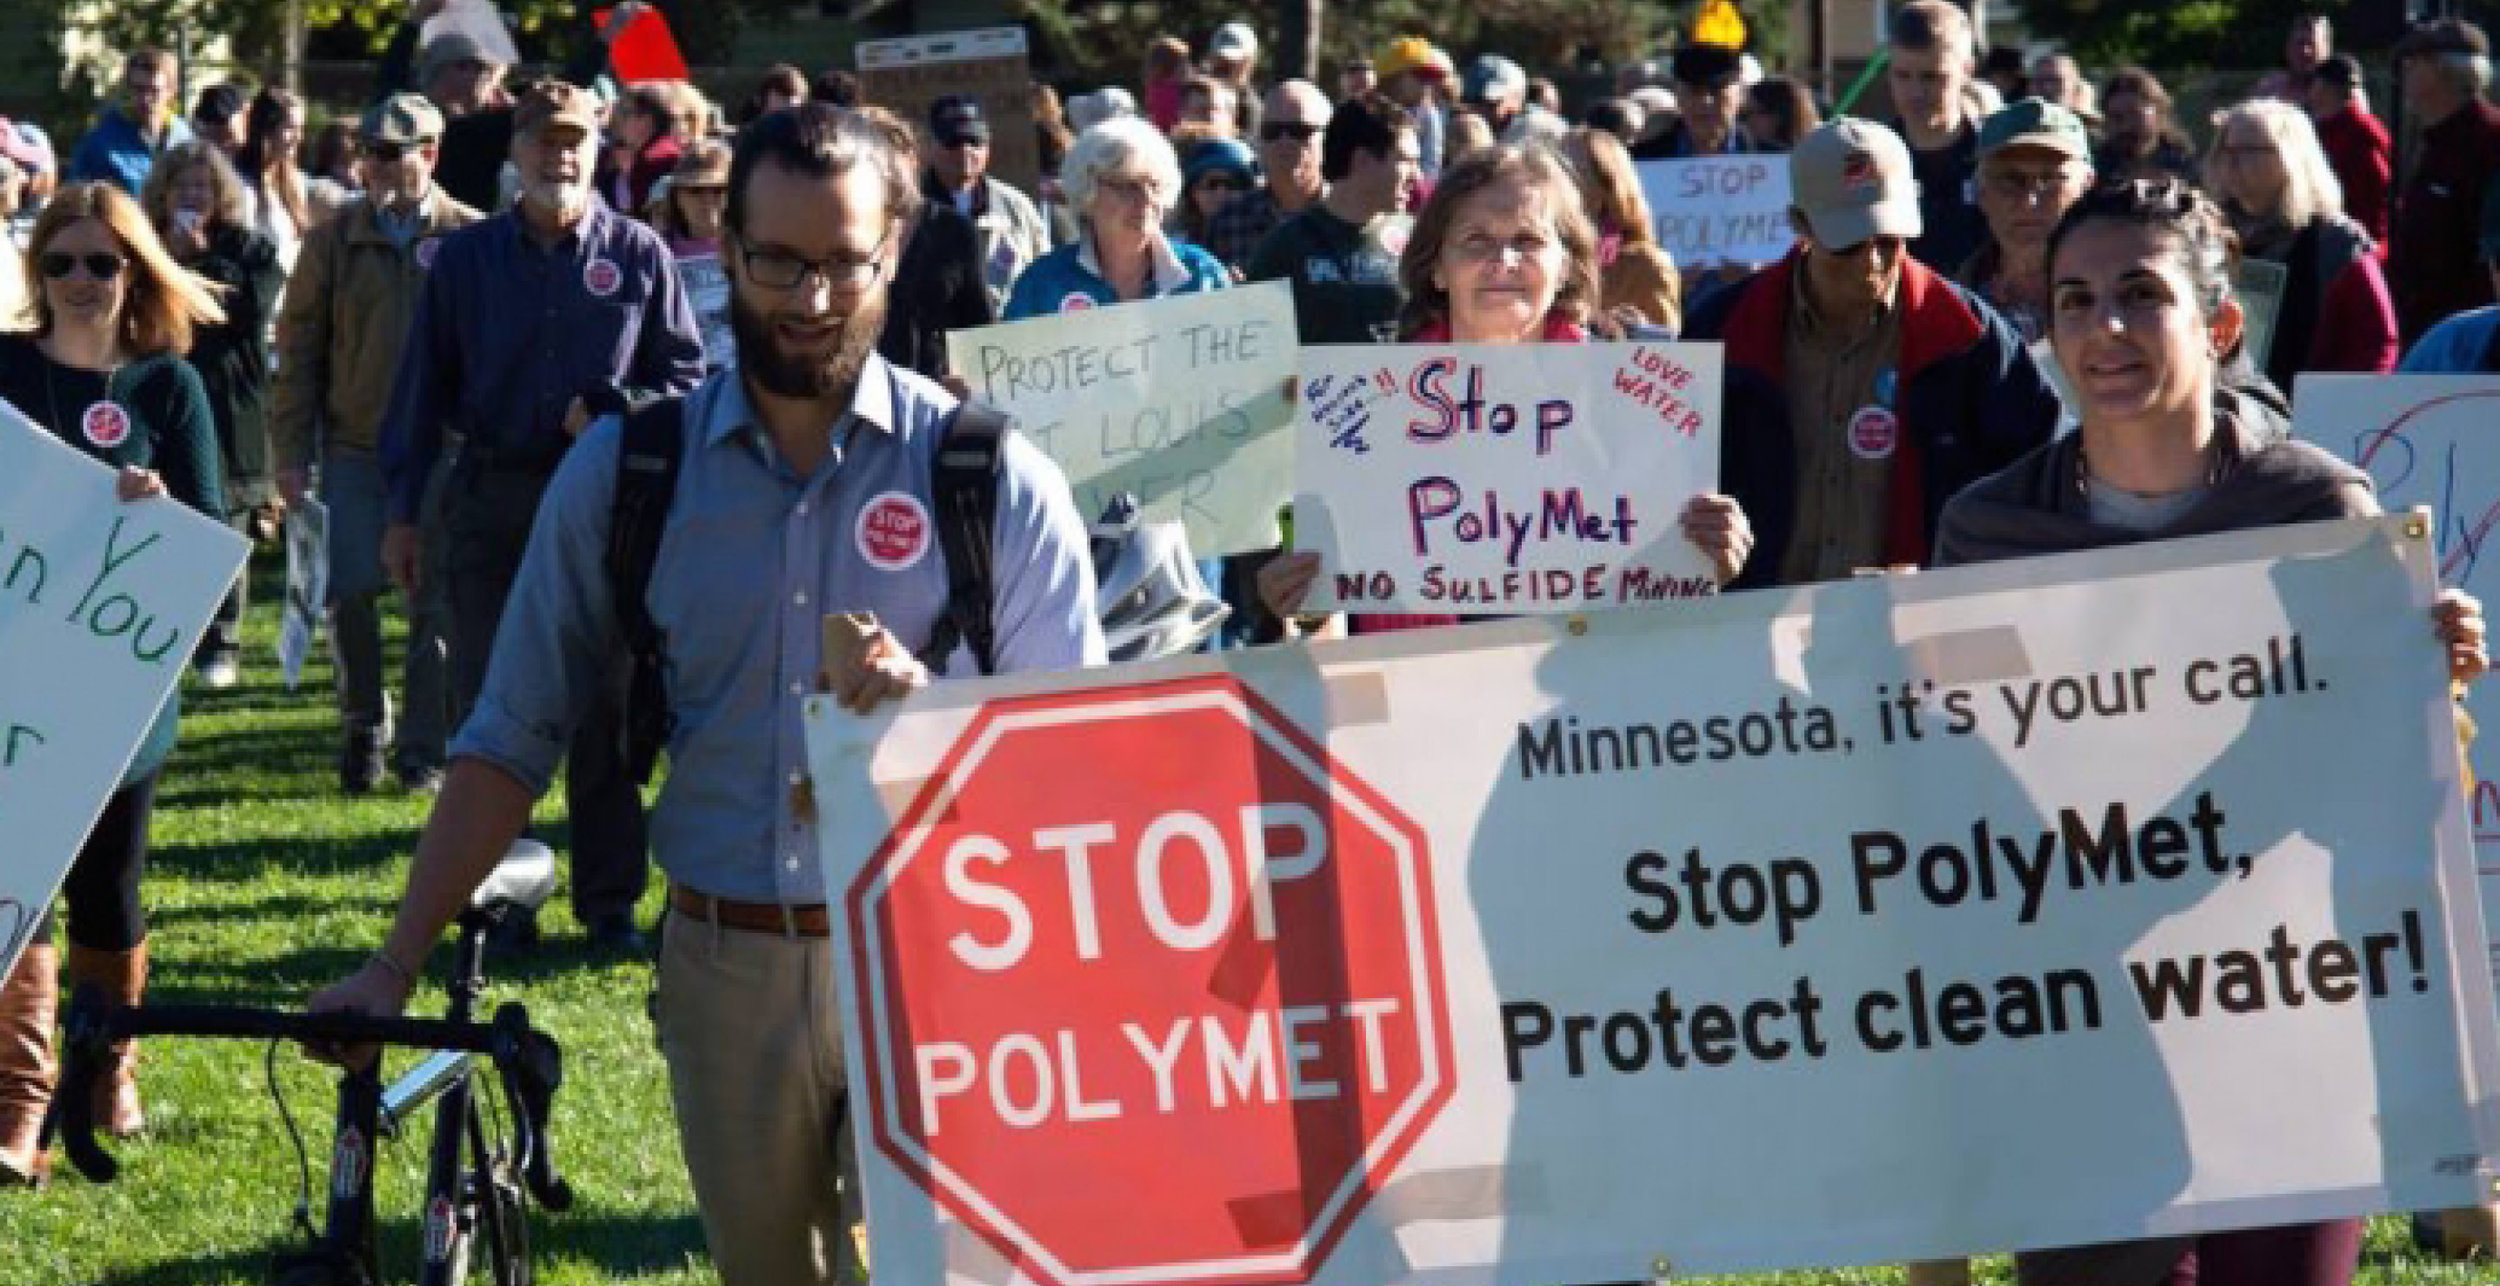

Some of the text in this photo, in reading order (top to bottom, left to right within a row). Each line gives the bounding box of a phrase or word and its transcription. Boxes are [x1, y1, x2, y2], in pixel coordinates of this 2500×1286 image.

[1677, 163, 1769, 198] STOP
[1657, 210, 1790, 252] POLYME
[978, 320, 1270, 404] PROTECT THE
[1406, 356, 1573, 456] Stop
[1613, 367, 1703, 438] WATER
[1631, 346, 1693, 390] LOVE
[1334, 568, 1398, 601] NO
[1517, 630, 2329, 782] Minnesota, it's your call.
[942, 801, 1329, 972] STOP
[1624, 790, 2254, 948] Stop PolyMet,
[1500, 907, 2429, 1083] Protect clean water!
[914, 997, 1401, 1138] POLYMET
